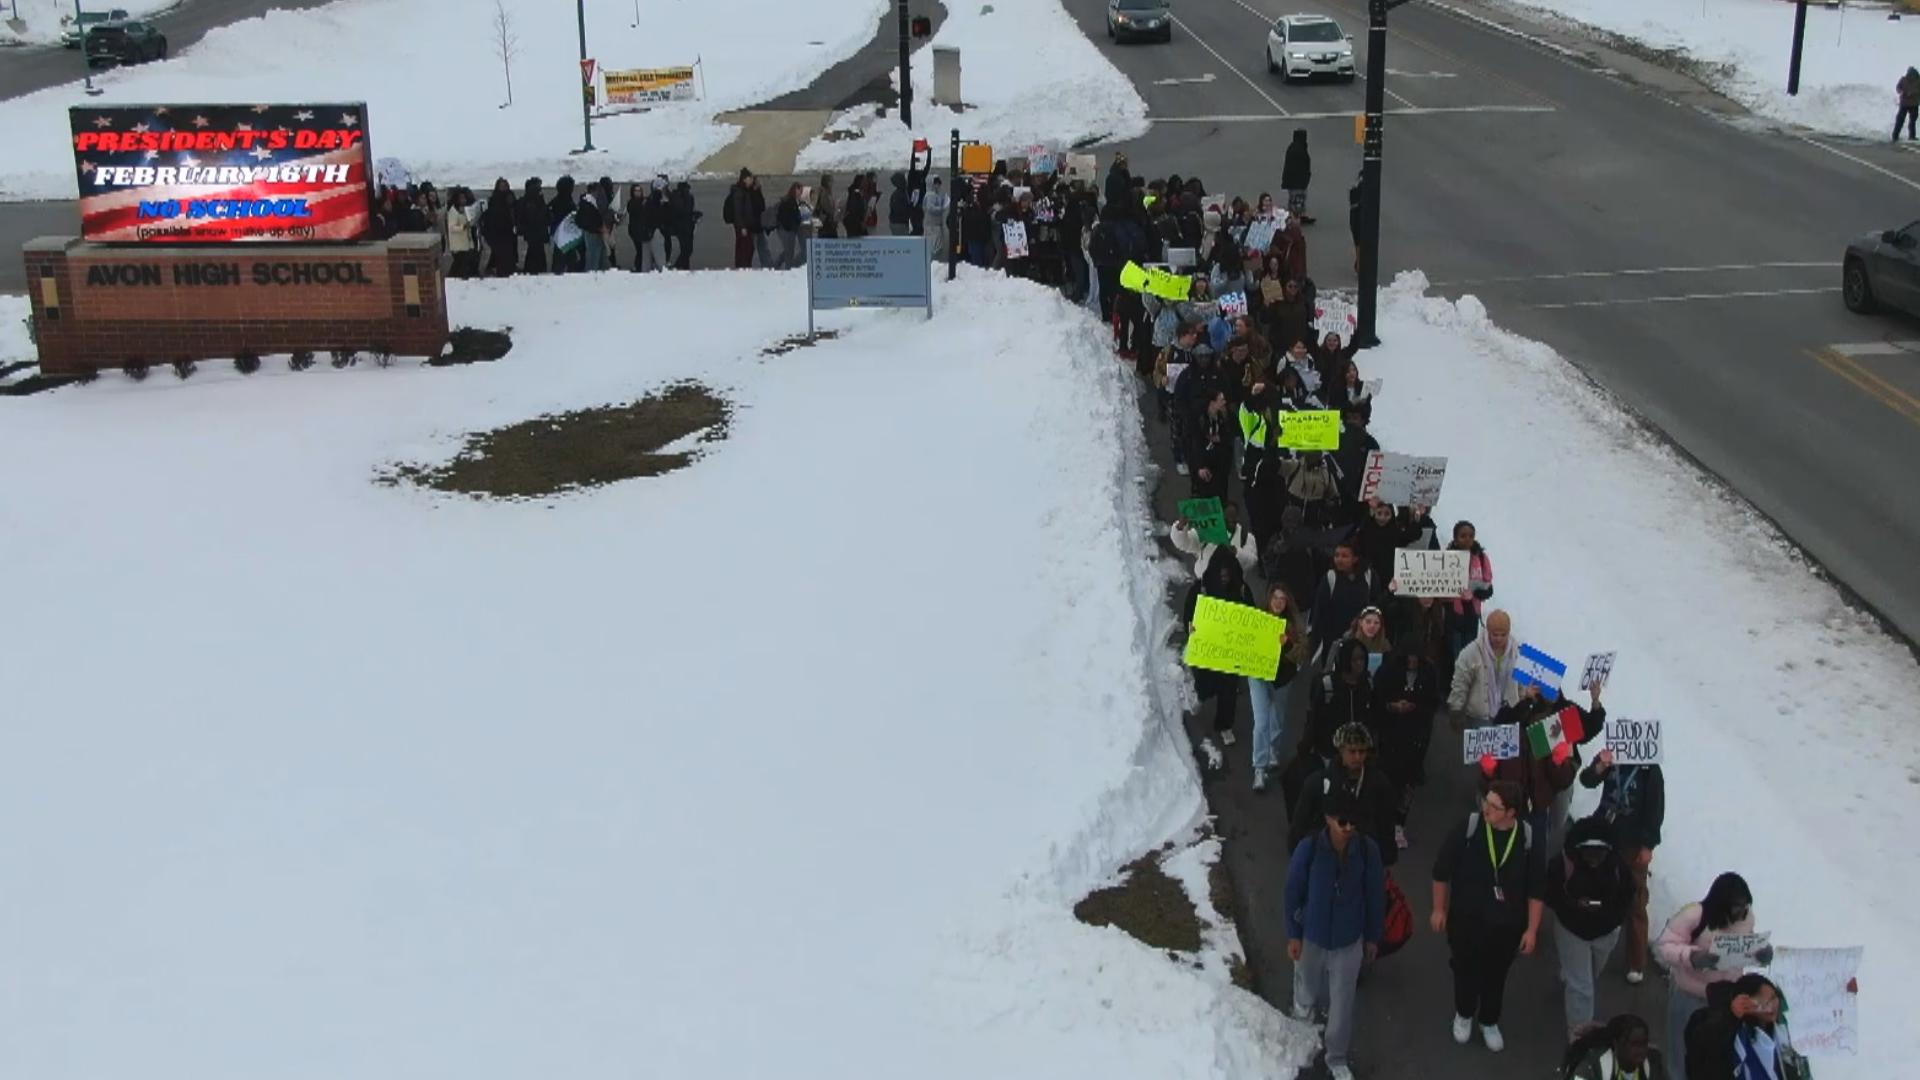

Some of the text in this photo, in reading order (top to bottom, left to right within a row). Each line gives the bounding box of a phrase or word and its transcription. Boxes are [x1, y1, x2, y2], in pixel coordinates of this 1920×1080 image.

[77, 129, 362, 150] PRESIDENT'S DAY
[94, 164, 350, 185] FEBRUARY 16TH
[138, 198, 312, 219] NO SCHOOL
[86, 262, 372, 286] AVON HIGH SCHOOL
[1605, 720, 1643, 740] LOUD
[1605, 741, 1659, 761] PROUD
